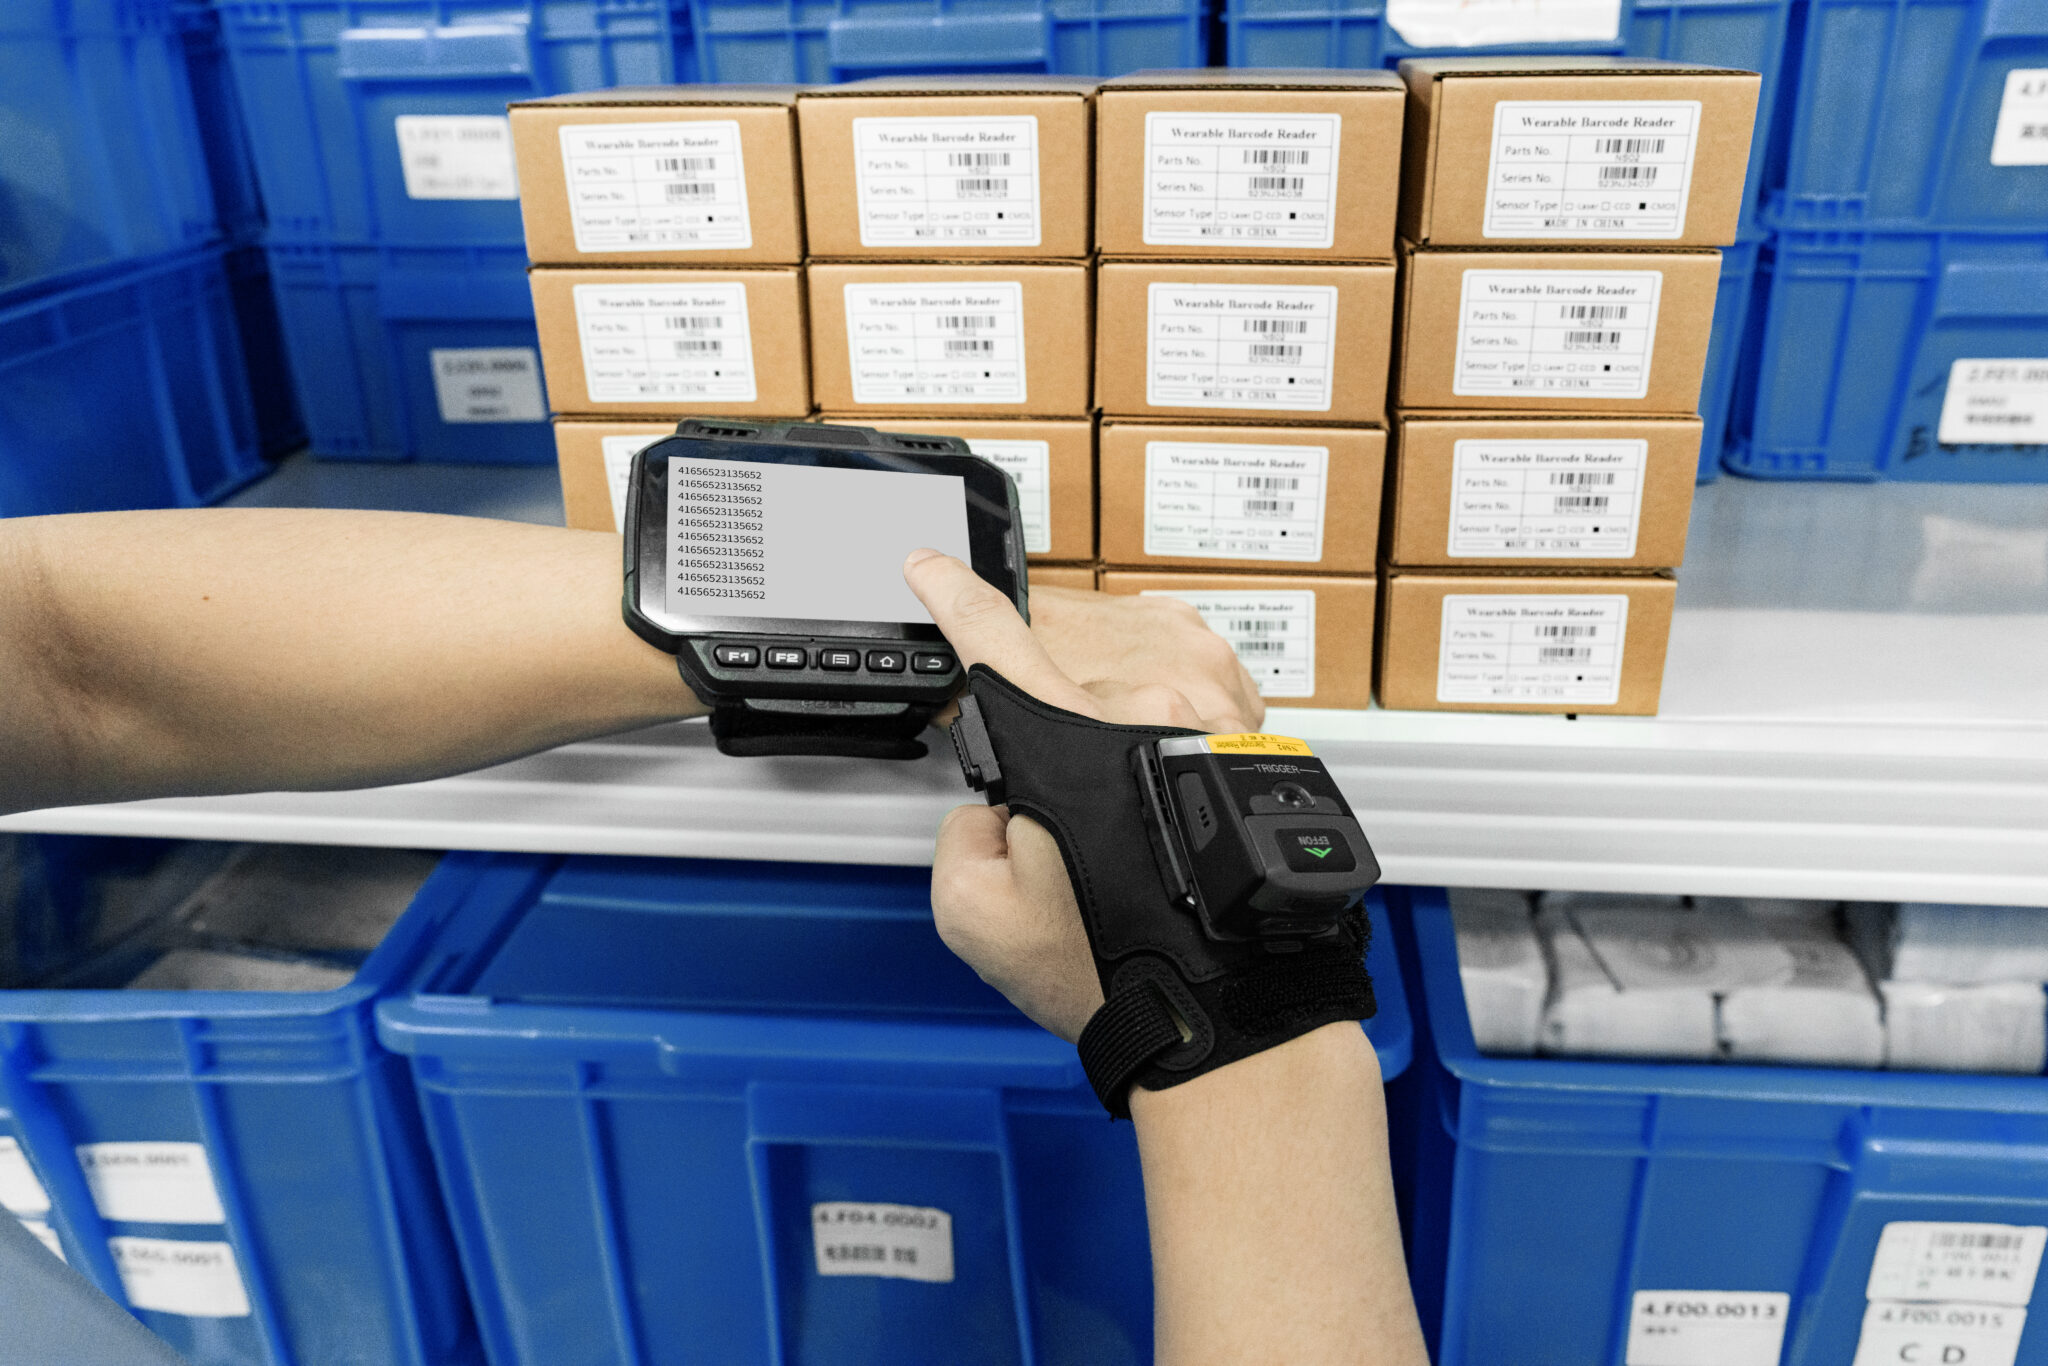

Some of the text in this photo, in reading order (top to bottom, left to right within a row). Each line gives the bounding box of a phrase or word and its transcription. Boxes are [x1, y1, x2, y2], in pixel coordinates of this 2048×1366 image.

[1520, 116, 1676, 127] Wearable Barcode Reader
[878, 131, 1016, 142] Wearable Barcode Reader
[1171, 127, 1317, 139] Wearable Barcode Reader
[1504, 145, 1531, 155] Parts
[1158, 155, 1182, 165] Parts
[1501, 173, 1532, 182] Series
[1157, 182, 1185, 191] Series
[1495, 200, 1529, 209] Sensor
[1533, 200, 1558, 211] Type
[1153, 208, 1185, 217] Sensor
[1189, 208, 1212, 219] Type
[1487, 284, 1638, 295] Wearable Barcode Reader
[868, 296, 1001, 306] Wearable Barcode Reader
[1173, 298, 1315, 310] Wearable Barcode Reader
[1472, 311, 1498, 320] Parts
[1470, 336, 1500, 345] Series
[1464, 360, 1497, 369] Sensor
[1501, 361, 1525, 371] Type
[1170, 455, 1307, 469] Wearable Barcode Reader
[1479, 453, 1624, 462] Wearable Barcode Reader
[678, 466, 762, 479] 41656523135652
[678, 479, 762, 492] 41656523135652
[678, 492, 762, 505] 41656523135652
[678, 505, 763, 518] 41656523135652
[678, 518, 763, 531] 41656523135652
[678, 532, 764, 545] 41656523135652
[678, 545, 764, 558] 41656523135652
[678, 559, 765, 572] 41656523135652
[678, 572, 765, 585] 41656523135652
[678, 586, 766, 600] 41656523135652
[728, 651, 749, 662] F1
[775, 652, 799, 663] F2
[1253, 764, 1300, 774] TRIGGER
[1297, 835, 1330, 846] EFFON
[1899, 1342, 1966, 1365] C D
